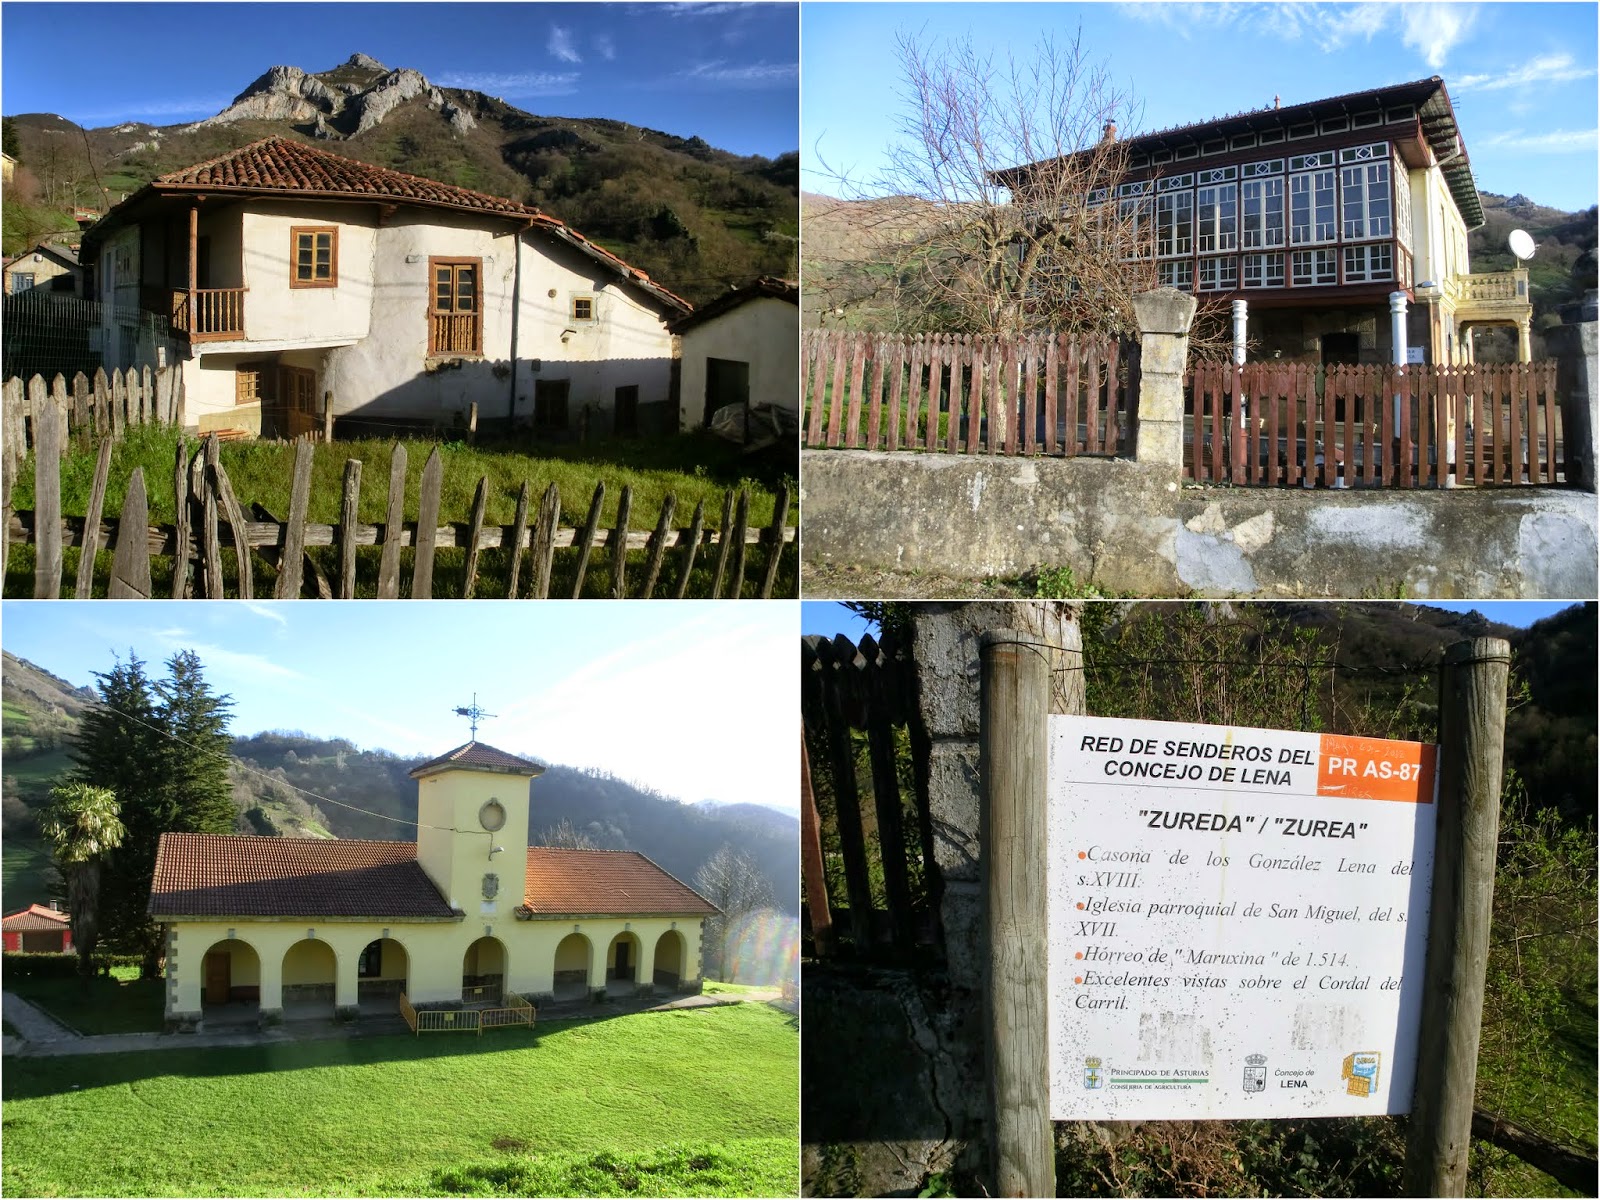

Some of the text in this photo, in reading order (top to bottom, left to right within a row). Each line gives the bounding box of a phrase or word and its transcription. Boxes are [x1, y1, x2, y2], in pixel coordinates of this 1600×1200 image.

[1080, 736, 1315, 766] RED DE SENDEROS DEL
[1104, 760, 1292, 786] CONCEJO DE LENA
[1328, 757, 1422, 781] PR AS-87
[1139, 810, 1368, 839] "ZUREDA" / "ZUREA"
[1087, 845, 1415, 876] Casona de los González Lena del
[1084, 896, 1408, 924] Iglesia parroquial de San Miguel, del s.
[1074, 921, 1119, 937] XVII.
[1083, 946, 1143, 962] Hórreo
[1148, 948, 1168, 963] de
[1281, 951, 1300, 966] de
[1306, 951, 1350, 967] 1.514.
[1083, 970, 1404, 991] Excelentes vistas sobre el Cordal del
[1075, 994, 1129, 1010] Carril.
[1274, 1068, 1304, 1078] Concejo
[1280, 1080, 1308, 1089] LENA
